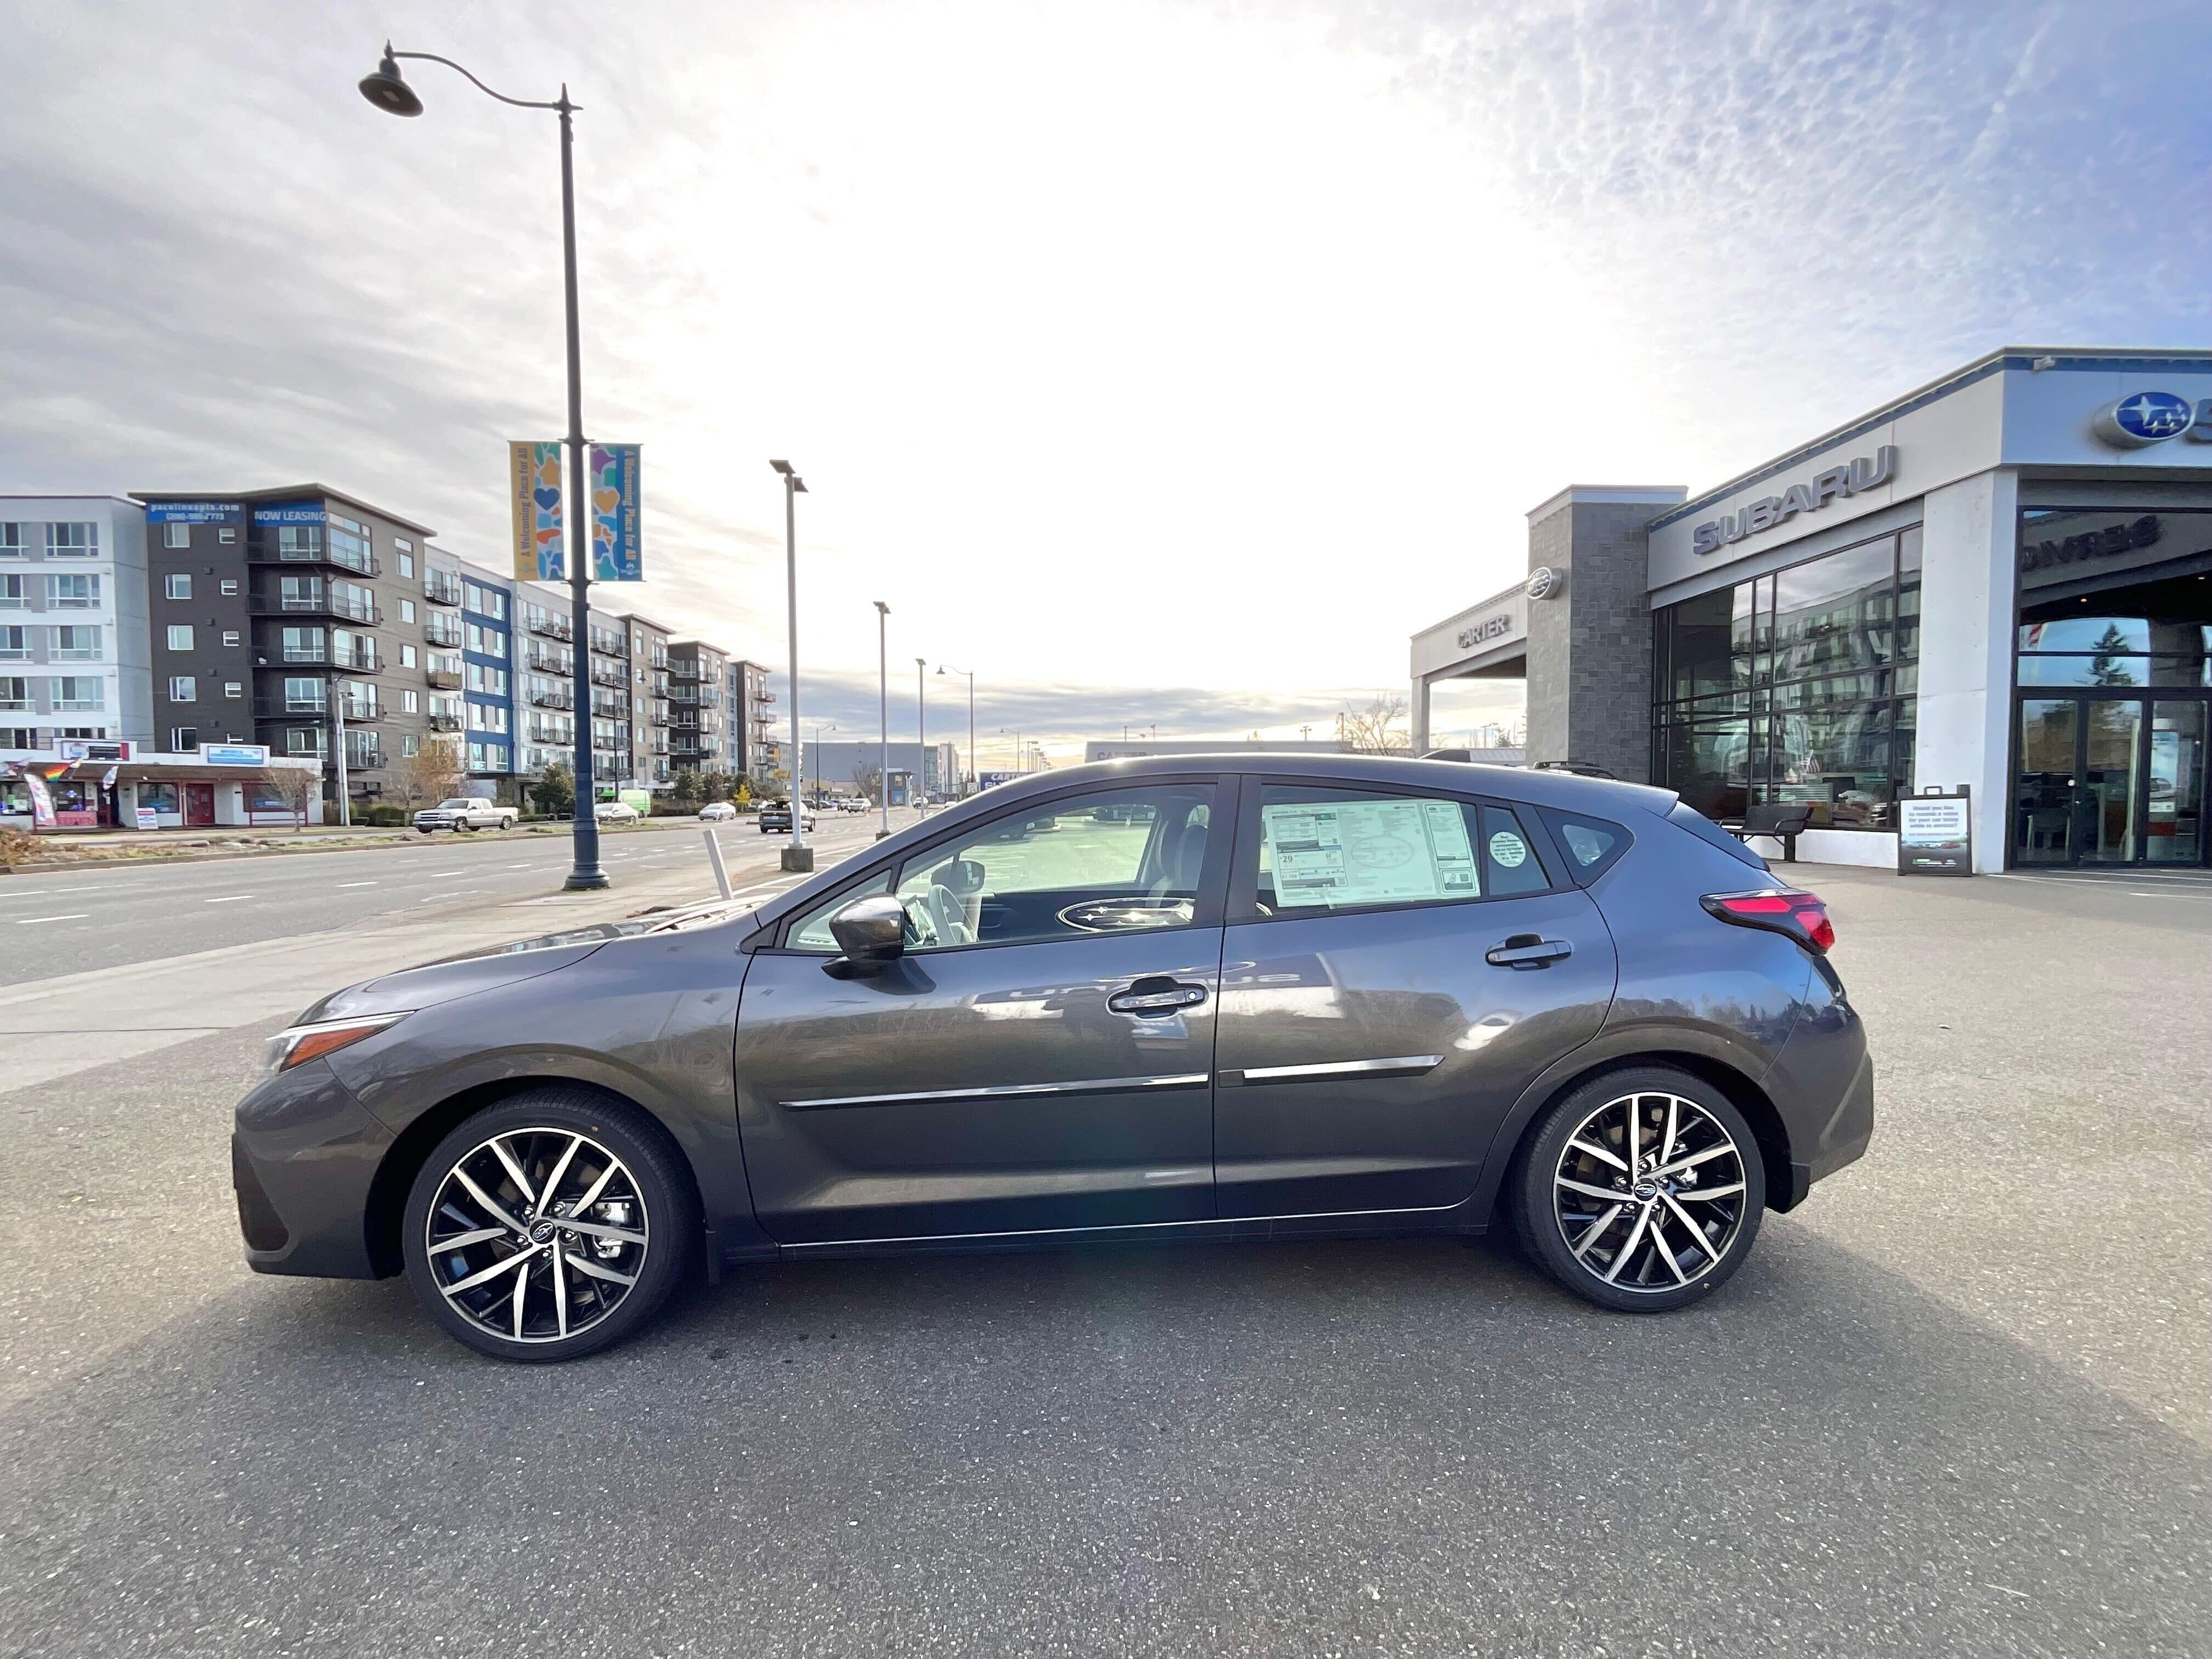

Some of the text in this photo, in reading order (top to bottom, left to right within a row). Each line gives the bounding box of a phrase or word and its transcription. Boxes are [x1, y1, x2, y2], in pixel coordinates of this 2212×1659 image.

[518, 448, 528, 459] All
[518, 462, 528, 473] for
[519, 475, 529, 499] Place
[622, 458, 635, 506] Welcoming
[1693, 445, 1896, 555] SUBARU
[255, 511, 326, 521] NOW LEASING
[625, 509, 635, 532] Place
[521, 502, 531, 549] Welcoming
[625, 534, 636, 546] for
[625, 549, 636, 560] All
[1457, 614, 1511, 648] CARTER
[991, 772, 1028, 781] CARTE
